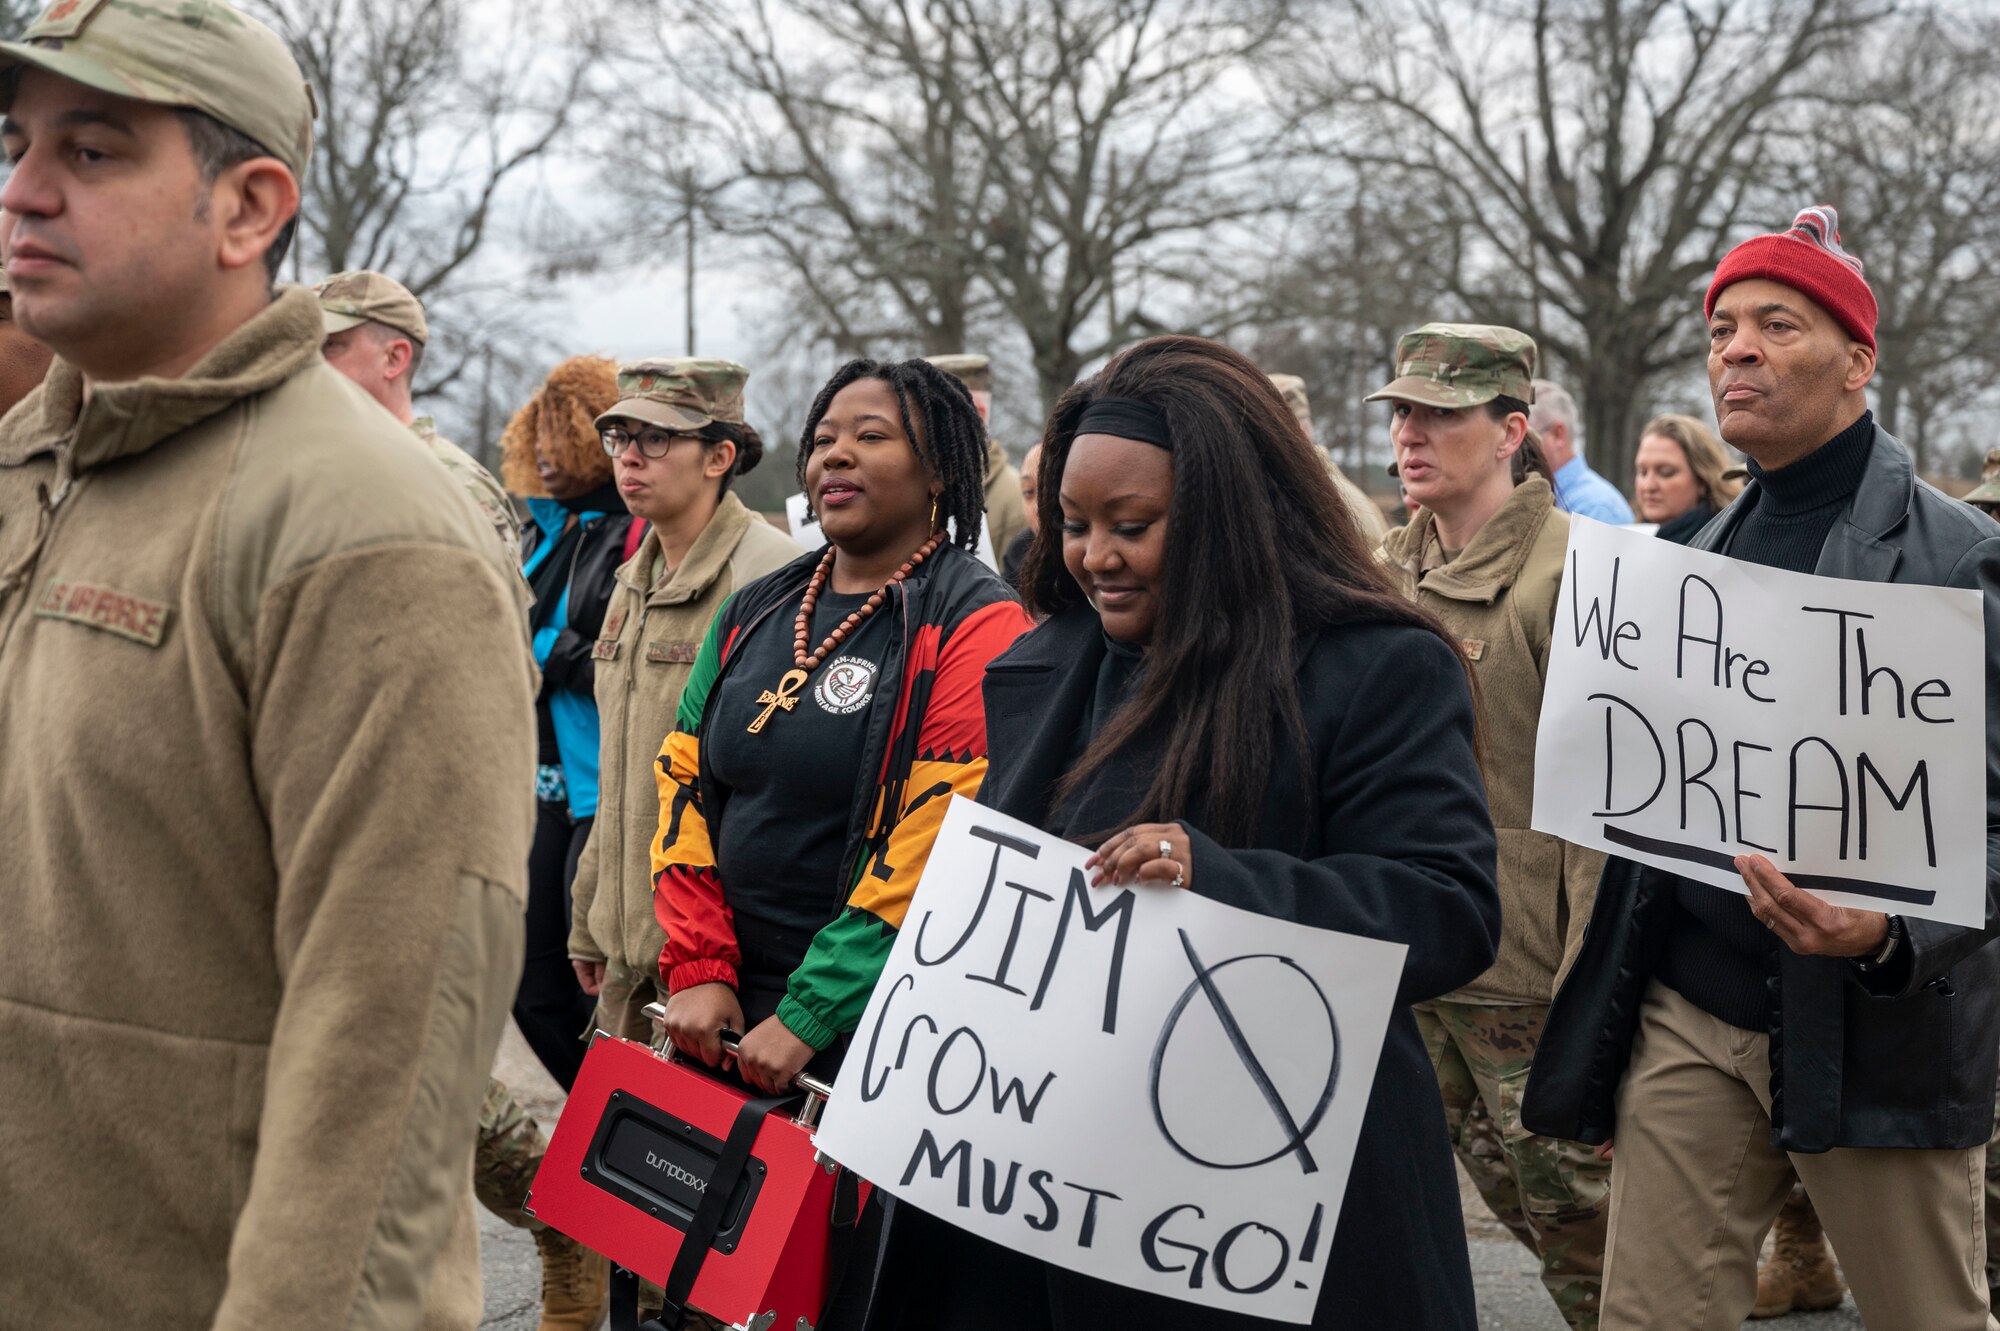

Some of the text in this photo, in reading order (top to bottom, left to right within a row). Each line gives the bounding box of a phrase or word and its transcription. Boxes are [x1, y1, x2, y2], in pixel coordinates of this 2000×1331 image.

[814, 684, 873, 714] HERITAGE COUNCIL
[1572, 549, 1955, 724] We Are The
[1587, 692, 1937, 868] DREAM
[913, 824, 1137, 1035] JIM
[645, 1149, 708, 1194] bumpboxx
[899, 1128, 1325, 1294] MUST GO!
